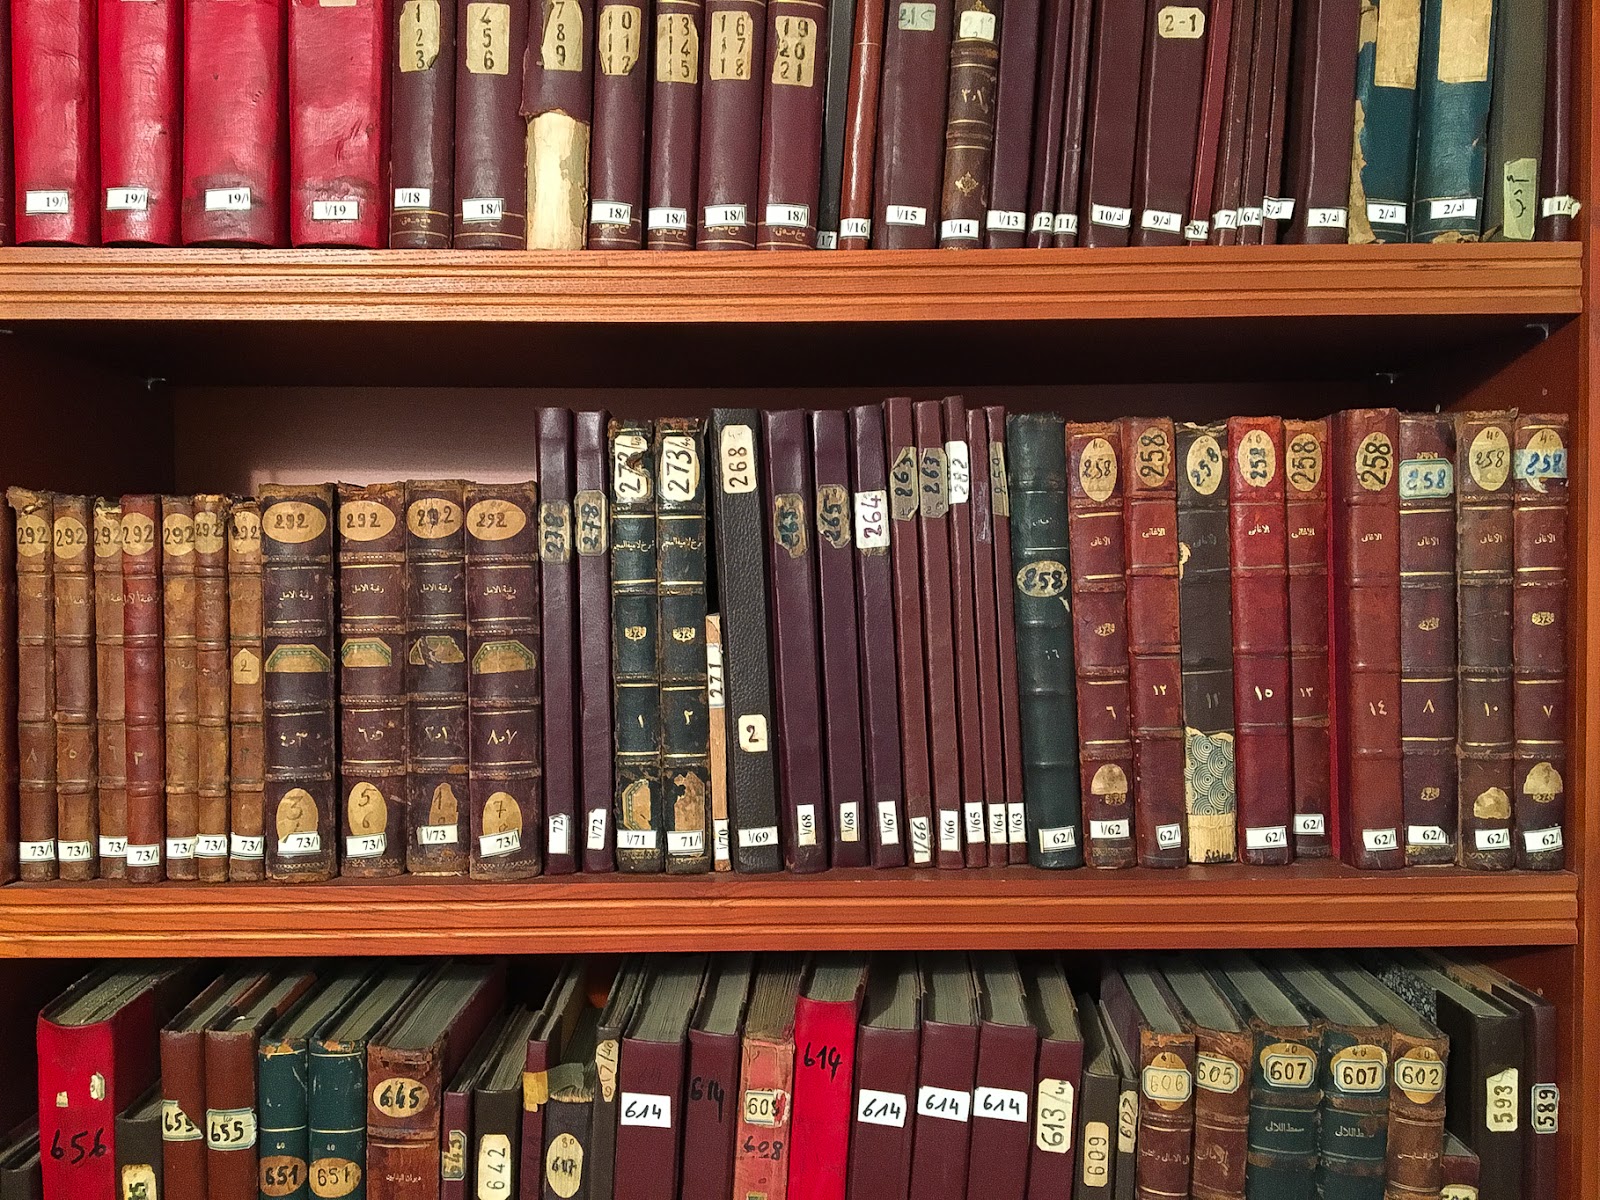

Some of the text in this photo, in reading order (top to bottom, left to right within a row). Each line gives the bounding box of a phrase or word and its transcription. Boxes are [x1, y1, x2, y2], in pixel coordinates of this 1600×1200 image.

[746, 724, 759, 743] 2
[1270, 1061, 1307, 1080] 607
[1343, 1066, 1377, 1084] 607
[1402, 1066, 1439, 1086] 602
[624, 1100, 662, 1120] 614
[862, 1099, 901, 1120] 614
[925, 1094, 959, 1115] 614
[983, 1094, 1020, 1115] 614
[1493, 1085, 1513, 1124] 593
[1538, 1089, 1556, 1127] 589
[317, 1167, 351, 1187] 651
[486, 1148, 506, 1190] 642
